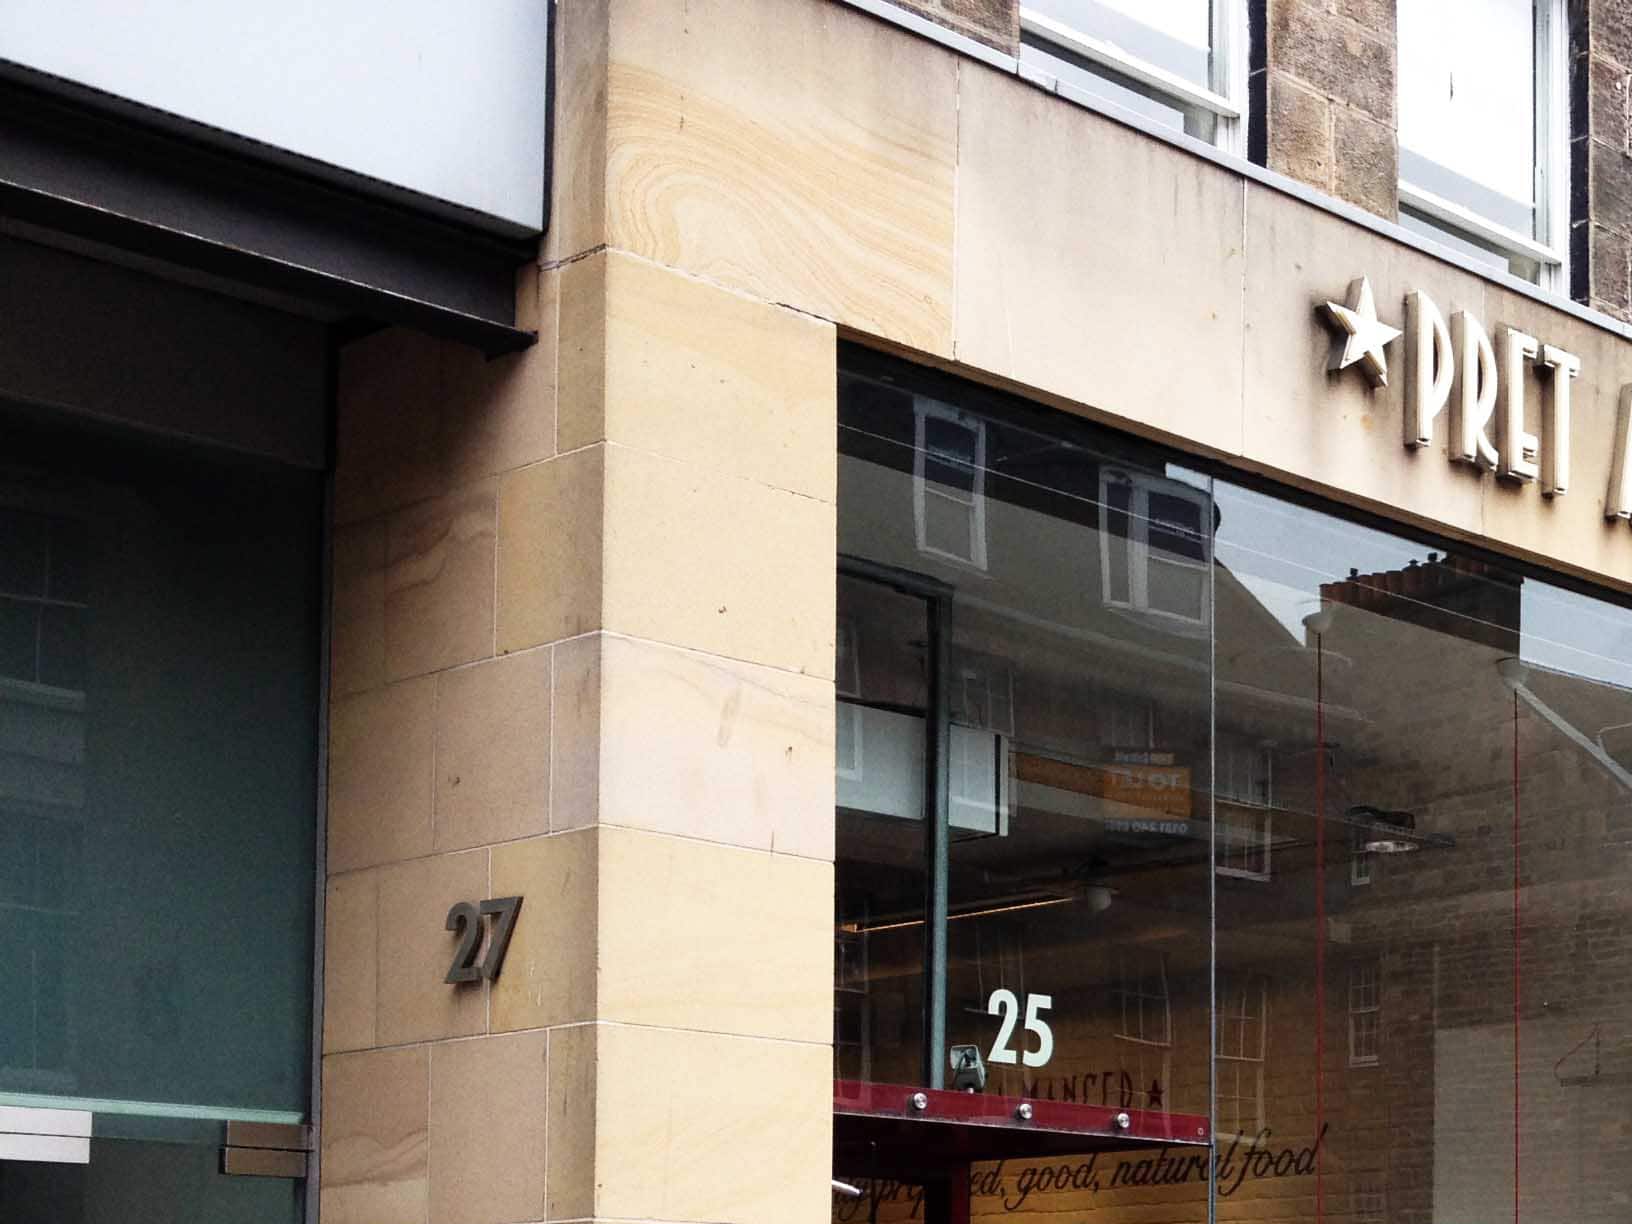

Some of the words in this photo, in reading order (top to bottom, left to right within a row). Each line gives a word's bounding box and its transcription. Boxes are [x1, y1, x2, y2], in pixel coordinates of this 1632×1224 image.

[1405, 289, 1580, 497] PRET
[444, 896, 523, 984] 27
[988, 989, 1053, 1067] 25
[1003, 1152, 1099, 1209] good,
[1111, 1129, 1233, 1188] natural
[1218, 1123, 1329, 1196] food
